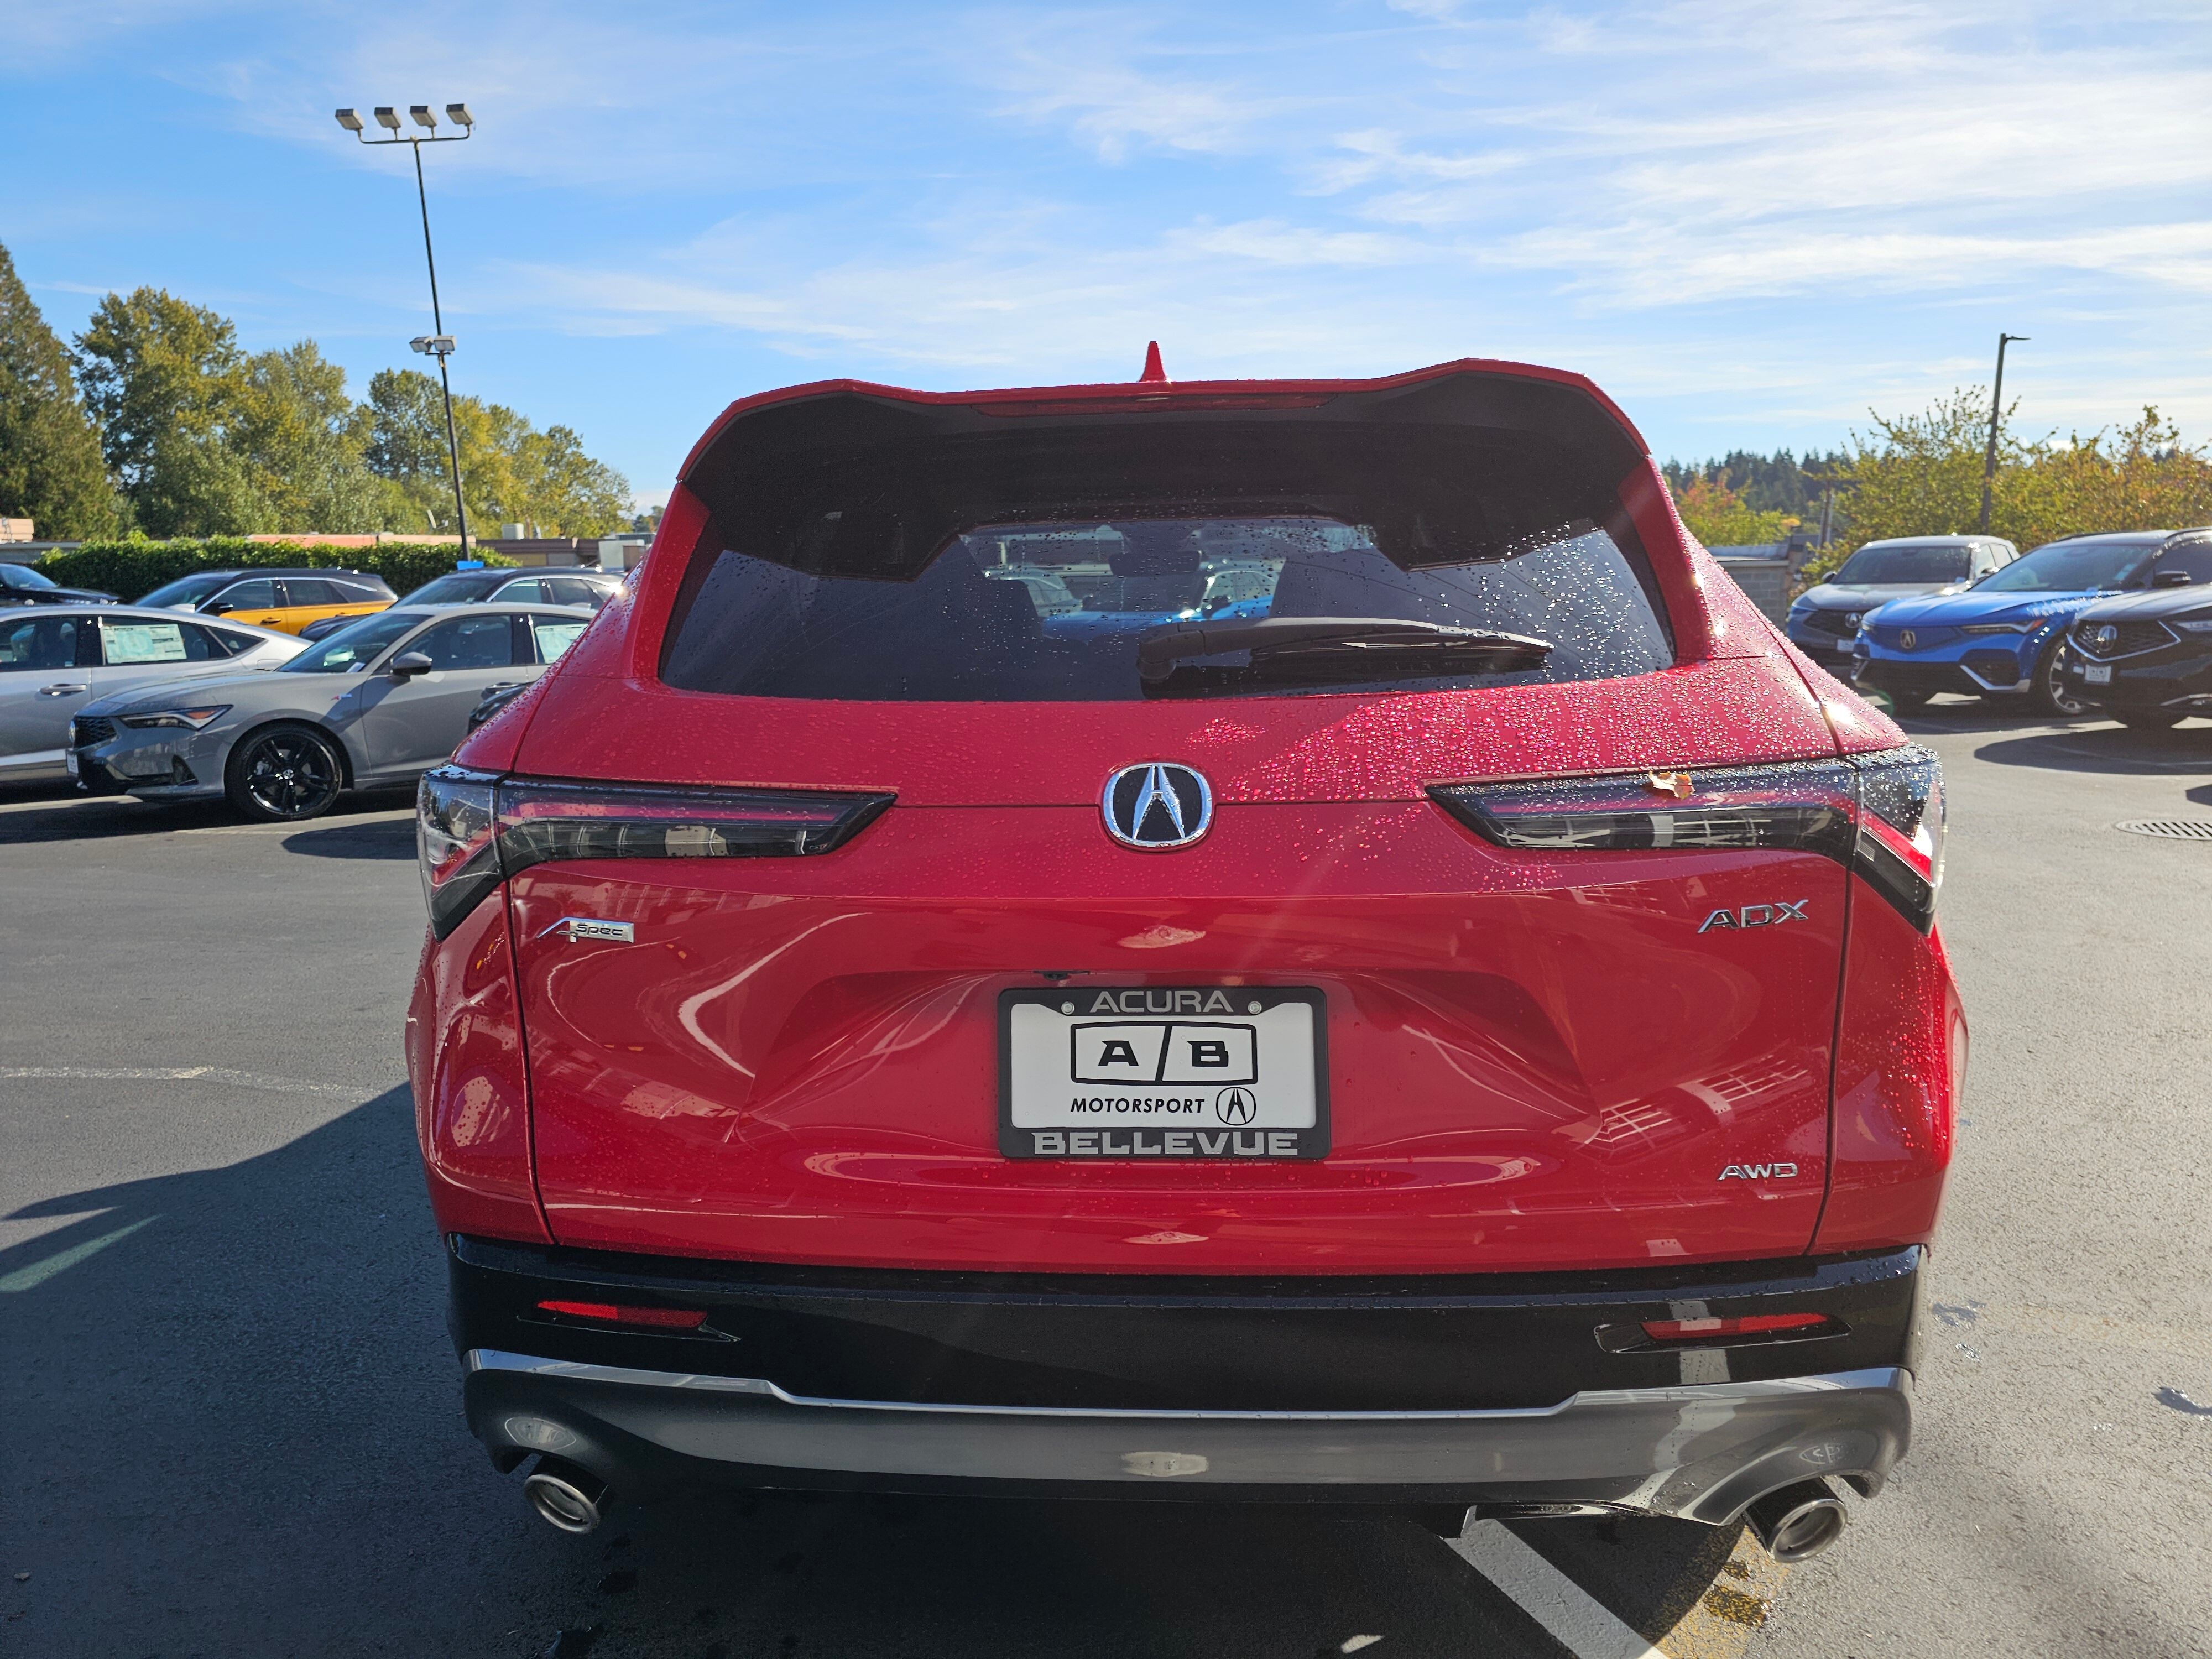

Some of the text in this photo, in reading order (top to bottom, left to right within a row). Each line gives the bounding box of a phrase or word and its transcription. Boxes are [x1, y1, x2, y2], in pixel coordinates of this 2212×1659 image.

[1697, 899, 1809, 933] ADX
[1089, 990, 1234, 1013] ACURA
[1098, 1040, 1229, 1067] A B
[1070, 1098, 1205, 1114] MOTORSPORT
[1031, 1132, 1299, 1156] BELLEVUE
[1717, 1162, 1798, 1181] AWD
